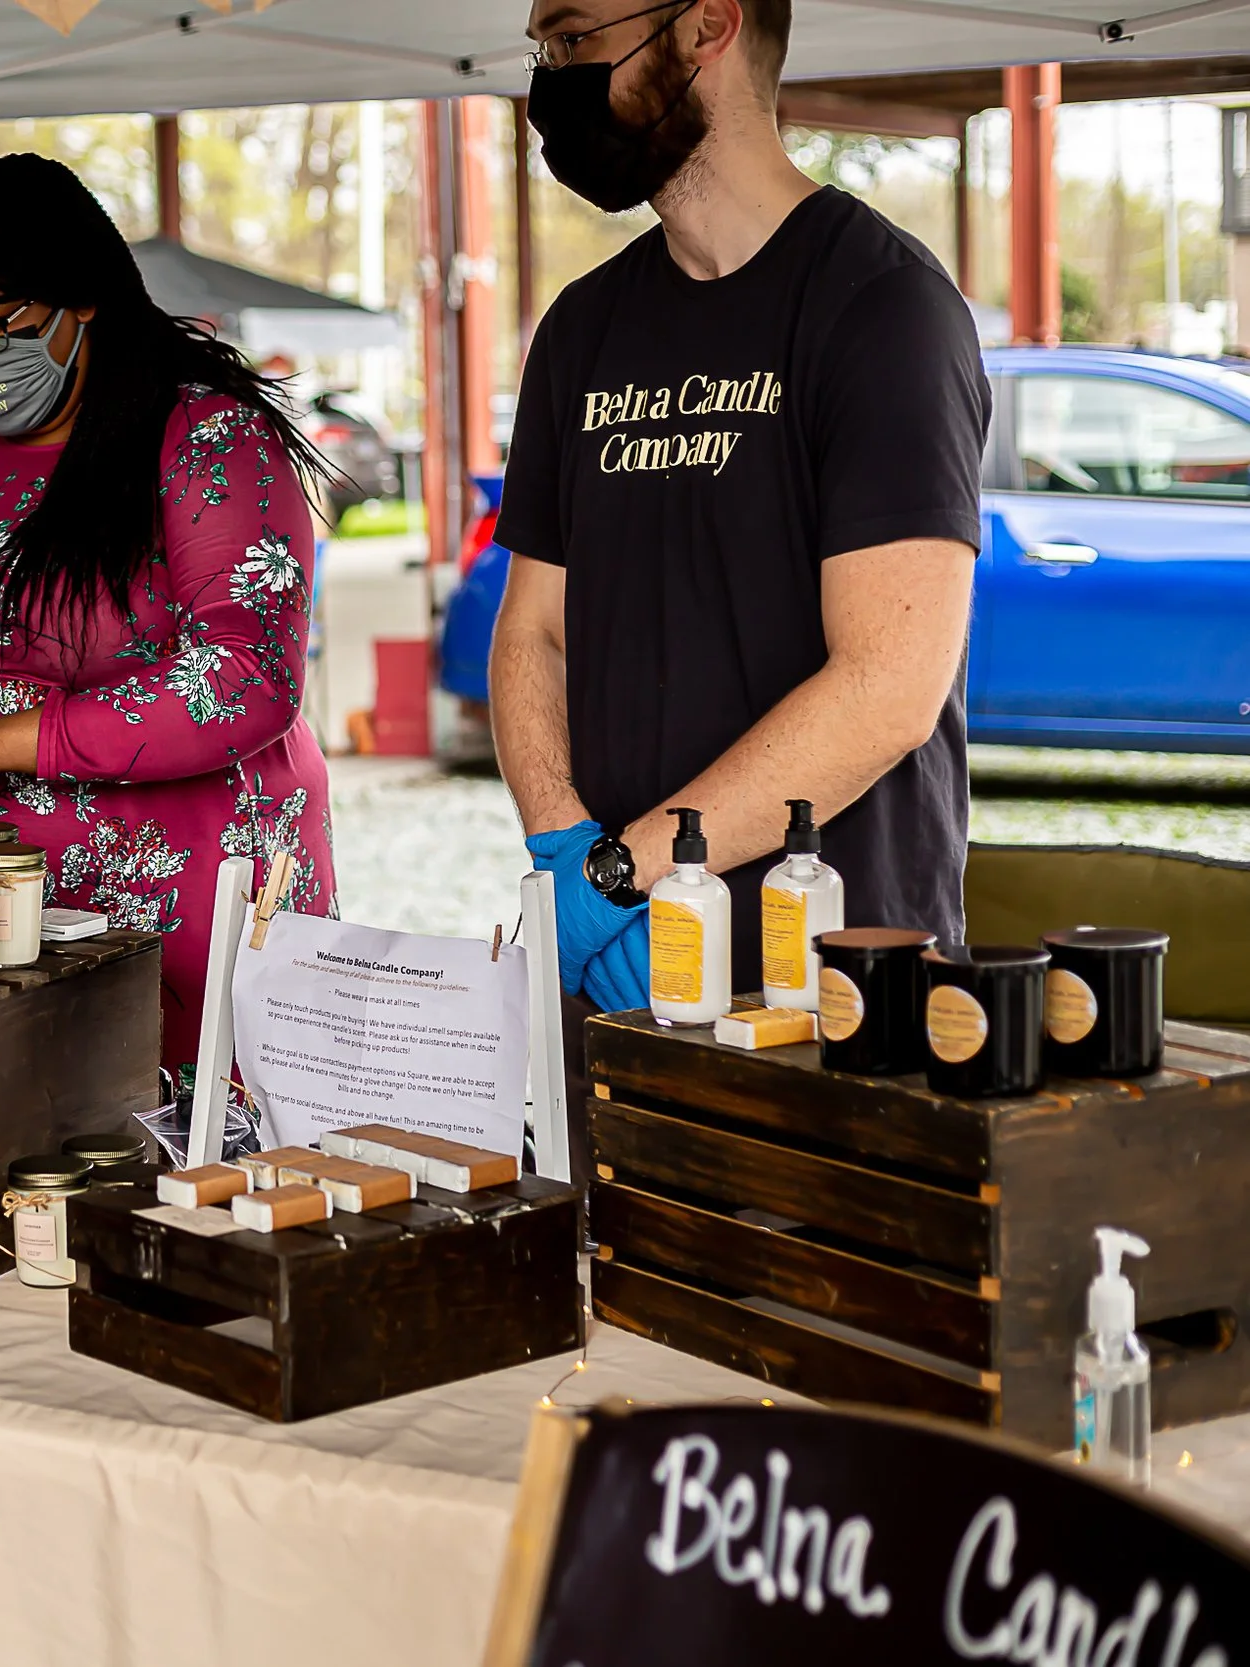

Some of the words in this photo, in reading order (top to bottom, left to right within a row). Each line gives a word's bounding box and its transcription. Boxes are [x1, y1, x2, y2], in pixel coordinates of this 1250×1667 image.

[582, 383, 671, 431] Belna
[678, 371, 782, 415] Candle
[600, 431, 742, 479] Company
[317, 951, 346, 964] Welcome
[346, 957, 353, 965] to
[354, 957, 371, 969] Belna
[372, 961, 399, 973] Candle
[400, 965, 444, 980] Company!
[329, 968, 349, 978] wellbeing
[412, 980, 438, 990] following
[335, 988, 350, 998] Please
[403, 1000, 420, 1008] times
[267, 997, 282, 1007] Please
[283, 1001, 293, 1011] only
[294, 1004, 308, 1013] touch
[309, 1008, 331, 1017] products
[331, 1013, 347, 1021] you're
[348, 1015, 368, 1027] buying!
[369, 1019, 379, 1027] We
[381, 1021, 395, 1029] have
[396, 1023, 427, 1032] individual
[446, 1030, 472, 1039] samples
[473, 1033, 501, 1041] available
[274, 1013, 283, 1021] you
[294, 1017, 322, 1027] experience
[331, 1025, 351, 1034] candle's
[369, 1031, 388, 1040] Please
[419, 1039, 450, 1047] assistance
[451, 1041, 468, 1049] when
[477, 1044, 496, 1052] doubt
[334, 1035, 350, 1045] before
[351, 1040, 371, 1051] picking
[381, 1045, 410, 1054] products!
[260, 1055, 271, 1063] cash,
[272, 1057, 288, 1066] please
[289, 1061, 301, 1069] allot
[305, 1064, 315, 1072] few
[315, 1068, 328, 1076] extra
[329, 1072, 349, 1080] minutes
[350, 1074, 358, 1082] for
[363, 1078, 381, 1086] glove
[382, 1080, 406, 1090] change!
[442, 1088, 456, 1097] only
[457, 1089, 472, 1097] have
[473, 1091, 495, 1099] limited
[262, 1043, 275, 1052] While
[320, 1057, 347, 1068] contactless
[348, 1064, 372, 1073] payment
[373, 1068, 395, 1076] options
[407, 1071, 430, 1081] Square,
[475, 1081, 495, 1090] accept
[338, 1084, 349, 1092] bills
[371, 1090, 395, 1100] change.
[275, 1092, 289, 1103] forget
[296, 1099, 310, 1107] social
[312, 1101, 334, 1113] distance,
[347, 1109, 365, 1118] above
[374, 1113, 388, 1121] have
[404, 1117, 415, 1125] This
[426, 1122, 451, 1132] amazing
[453, 1124, 467, 1132] time
[476, 1126, 484, 1134] be
[311, 1115, 335, 1126] outdoors,
[337, 1119, 351, 1129] shop
[644, 1432, 891, 1617] Belna
[944, 1495, 1230, 1667] Candl
